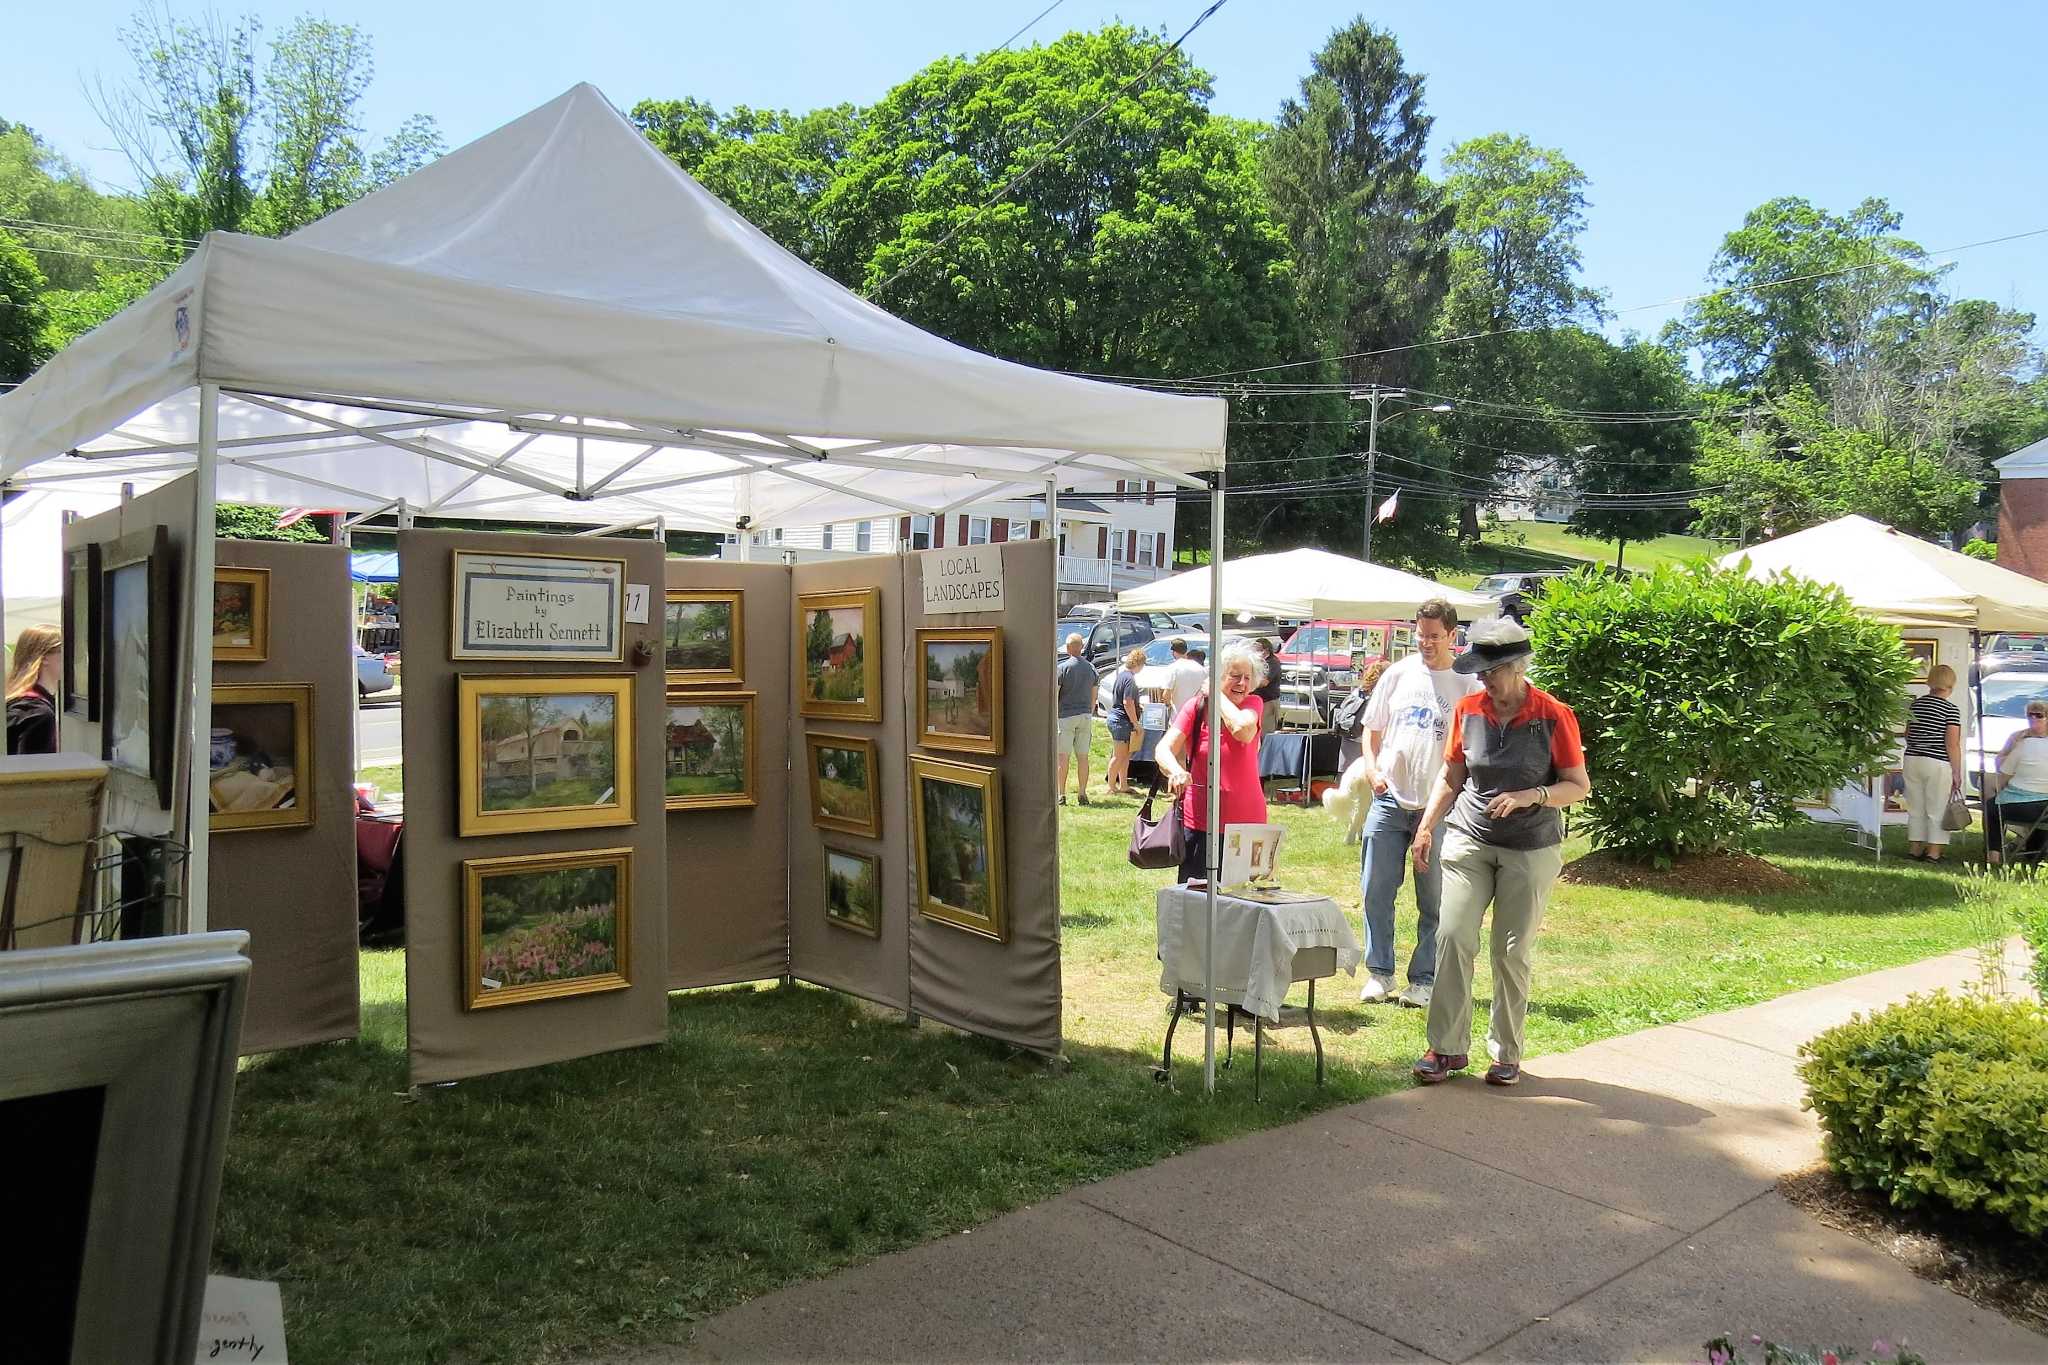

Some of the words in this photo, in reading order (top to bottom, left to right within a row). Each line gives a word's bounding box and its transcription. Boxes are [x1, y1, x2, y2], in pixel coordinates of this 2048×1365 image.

[940, 556, 981, 577] LOCAL
[506, 584, 575, 607] Paintings
[926, 581, 1000, 602] LANDSCAPES
[535, 605, 547, 618] by
[475, 620, 544, 640] Elizabeth
[549, 622, 601, 641] Sennett
[209, 1333, 264, 1362] gently
